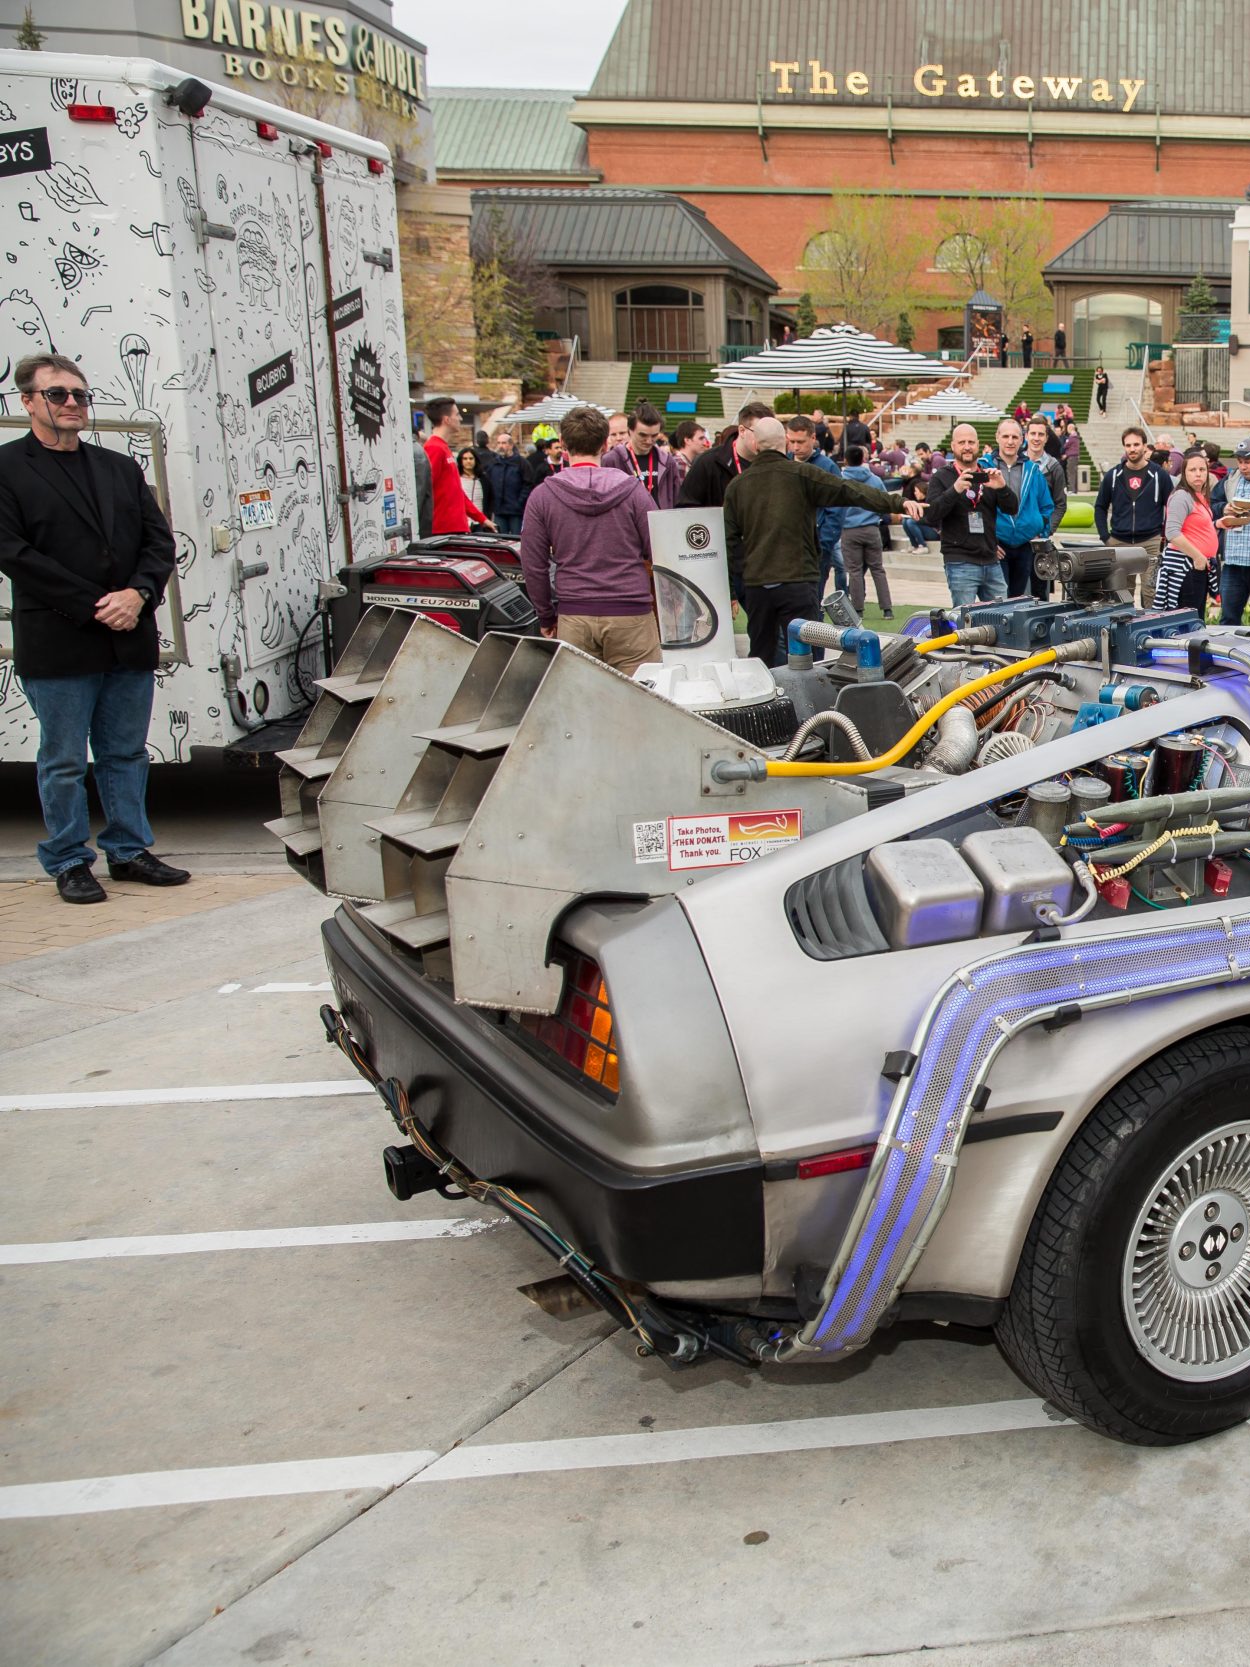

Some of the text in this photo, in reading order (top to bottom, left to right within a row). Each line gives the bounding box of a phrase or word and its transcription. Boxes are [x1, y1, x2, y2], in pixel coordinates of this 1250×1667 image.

[182, 0, 348, 66] BARNES
[372, 32, 425, 100] NOBLE
[769, 60, 1145, 112] The Gateway
[255, 363, 288, 393] @CUBBYS
[359, 357, 376, 378] NOW
[354, 372, 381, 401] HIRING
[366, 595, 400, 603] HONDA
[677, 828, 694, 836] Take
[679, 848, 721, 858] Thank you.
[730, 846, 762, 861] FOX
